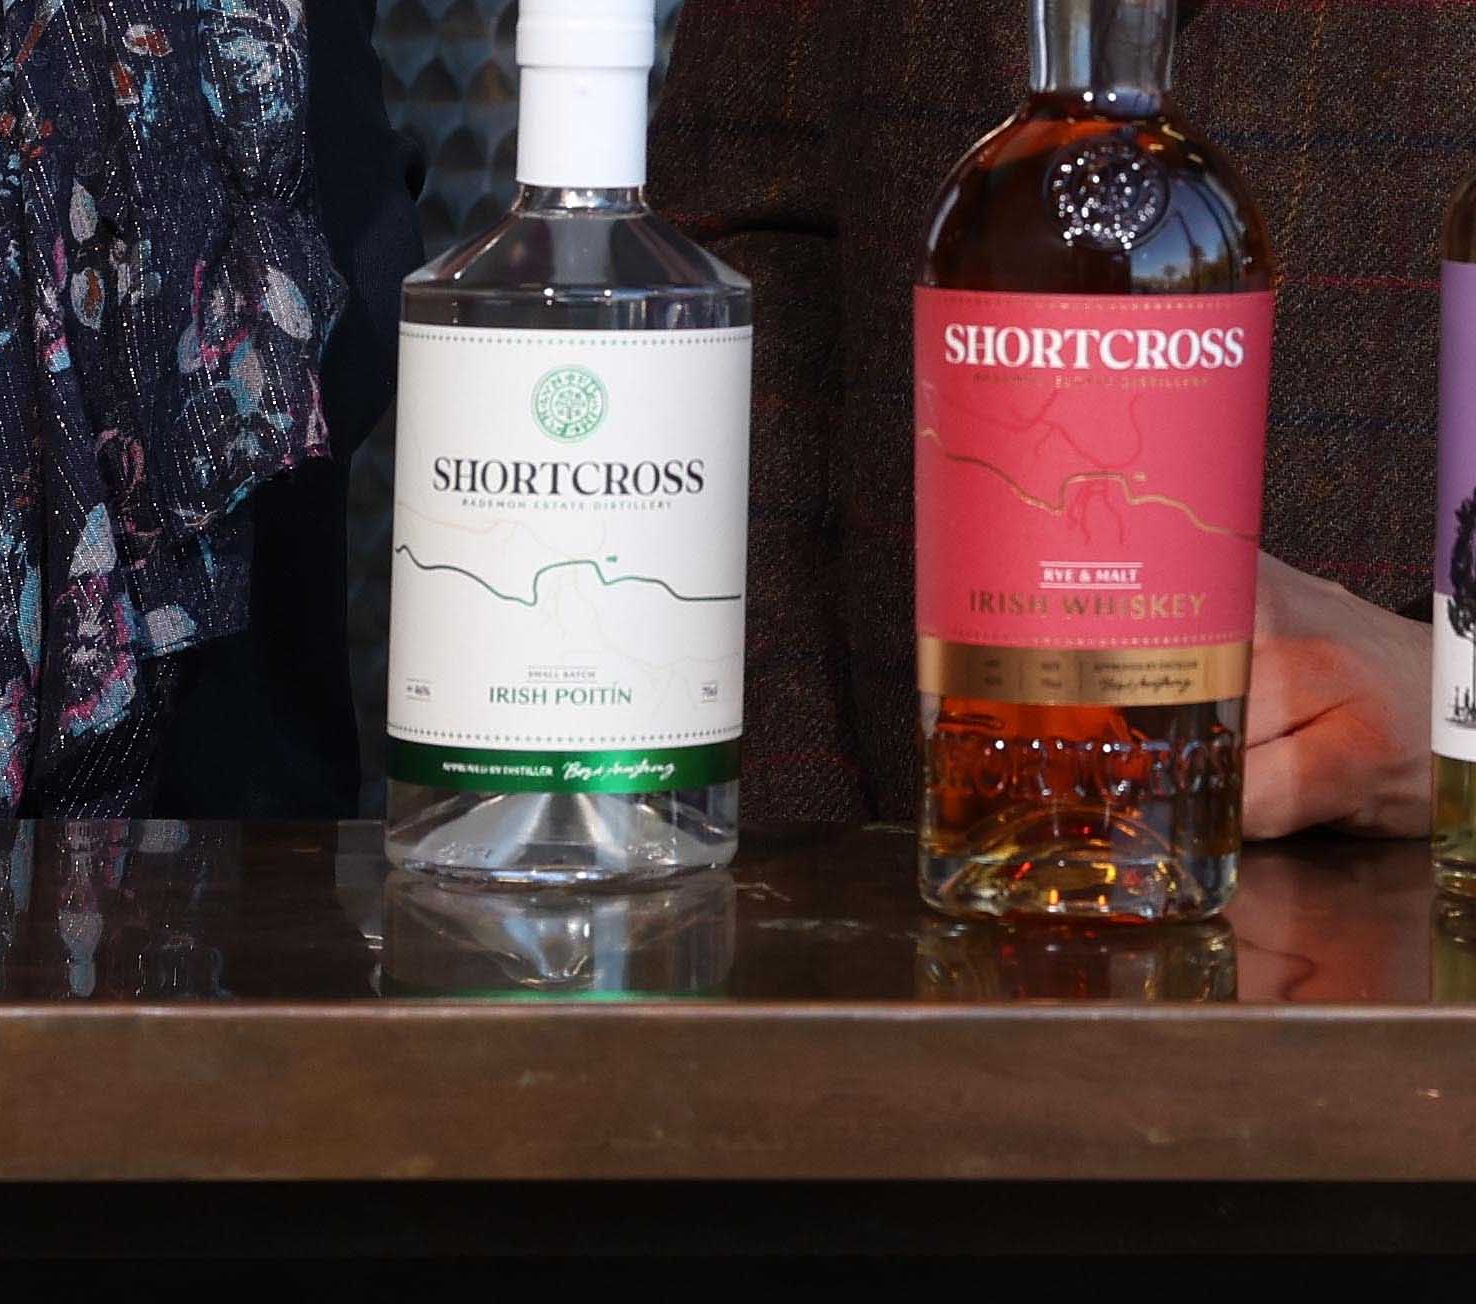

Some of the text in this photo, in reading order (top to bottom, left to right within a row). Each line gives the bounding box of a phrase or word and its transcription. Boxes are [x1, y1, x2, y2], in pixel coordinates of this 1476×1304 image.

[943, 323, 1245, 370] SHORTCROSS
[432, 456, 705, 496] SHORTCROSS
[1043, 569, 1138, 583] RYE & MALT
[968, 591, 1207, 619] IRISH WHISKEY
[489, 680, 633, 705] IRISH POITÍN
